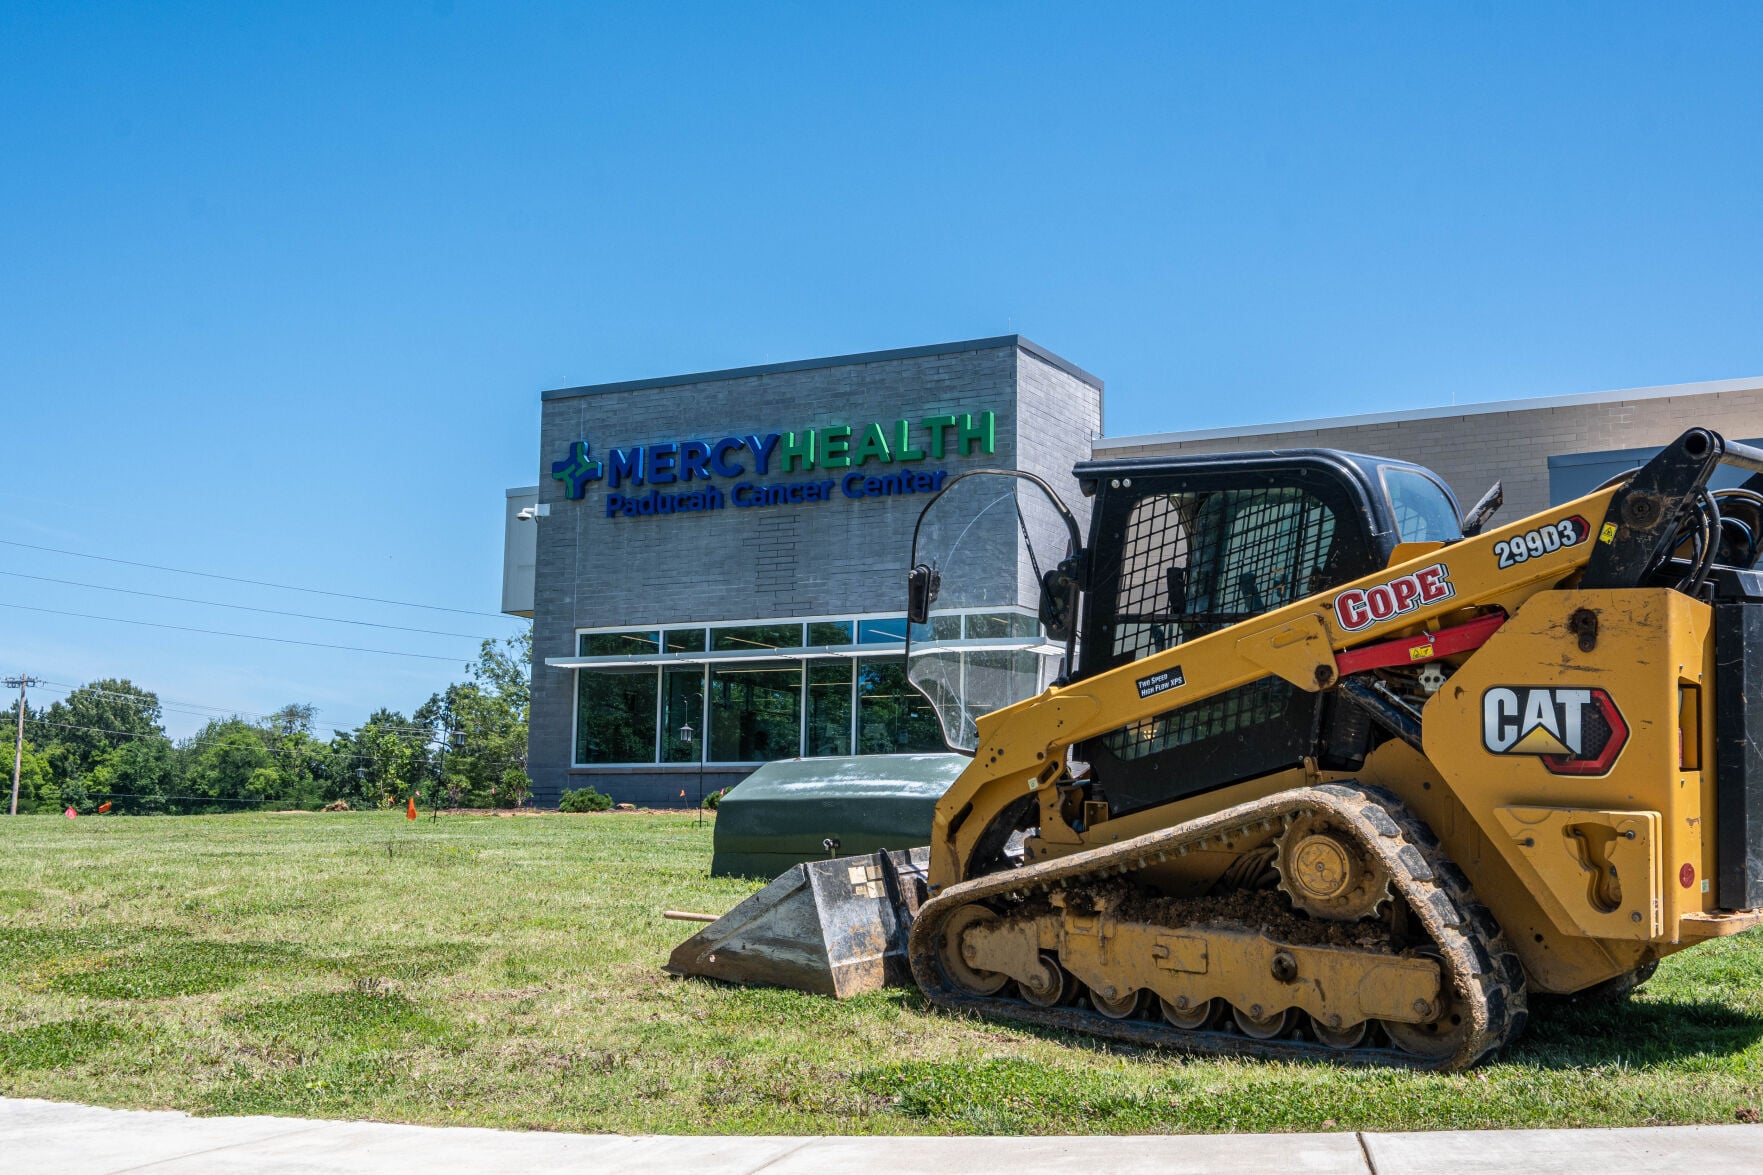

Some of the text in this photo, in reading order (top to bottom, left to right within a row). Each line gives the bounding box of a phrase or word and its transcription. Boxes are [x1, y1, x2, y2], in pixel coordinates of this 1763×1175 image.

[606, 468, 947, 518] Paducah Cancer Center
[1494, 519, 1577, 569] 299D3
[1335, 564, 1455, 631] COPE
[1141, 676, 1182, 696] HIGH FLOW XPS
[1151, 674, 1168, 684] SPEED
[1484, 687, 1591, 755] CAT
